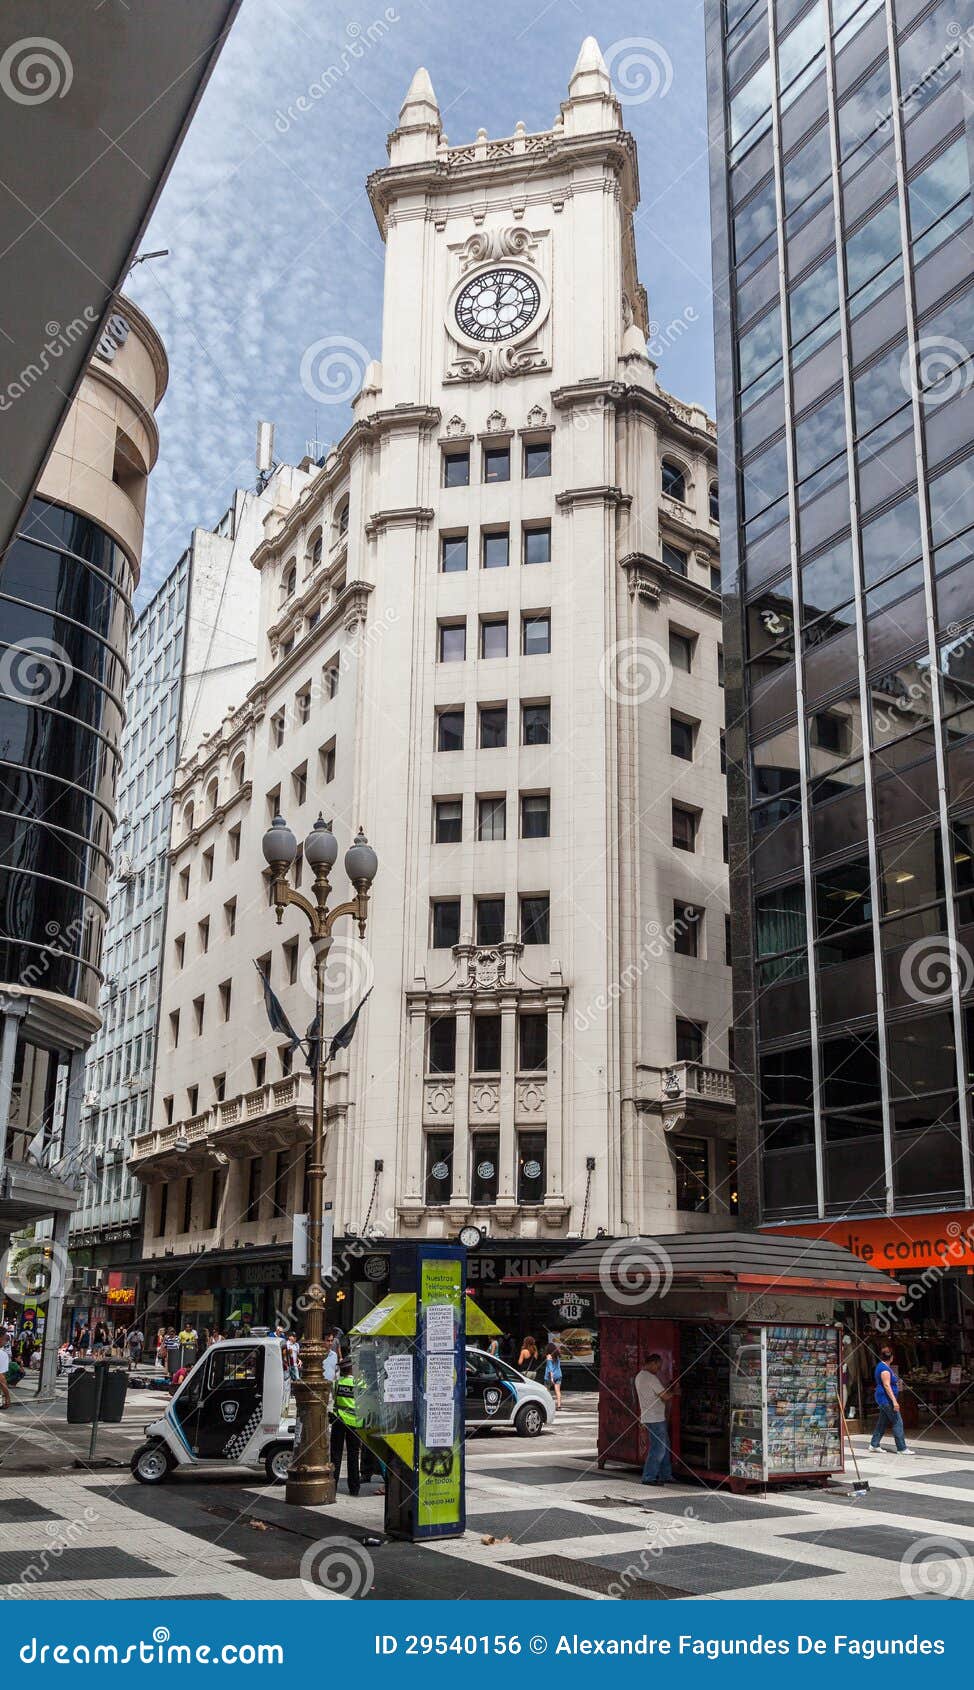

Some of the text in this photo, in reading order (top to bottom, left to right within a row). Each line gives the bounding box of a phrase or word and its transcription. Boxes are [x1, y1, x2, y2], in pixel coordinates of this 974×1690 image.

[884, 1240, 949, 1260] como
[505, 1258, 549, 1279] KIN
[567, 1306, 577, 1317] 18
